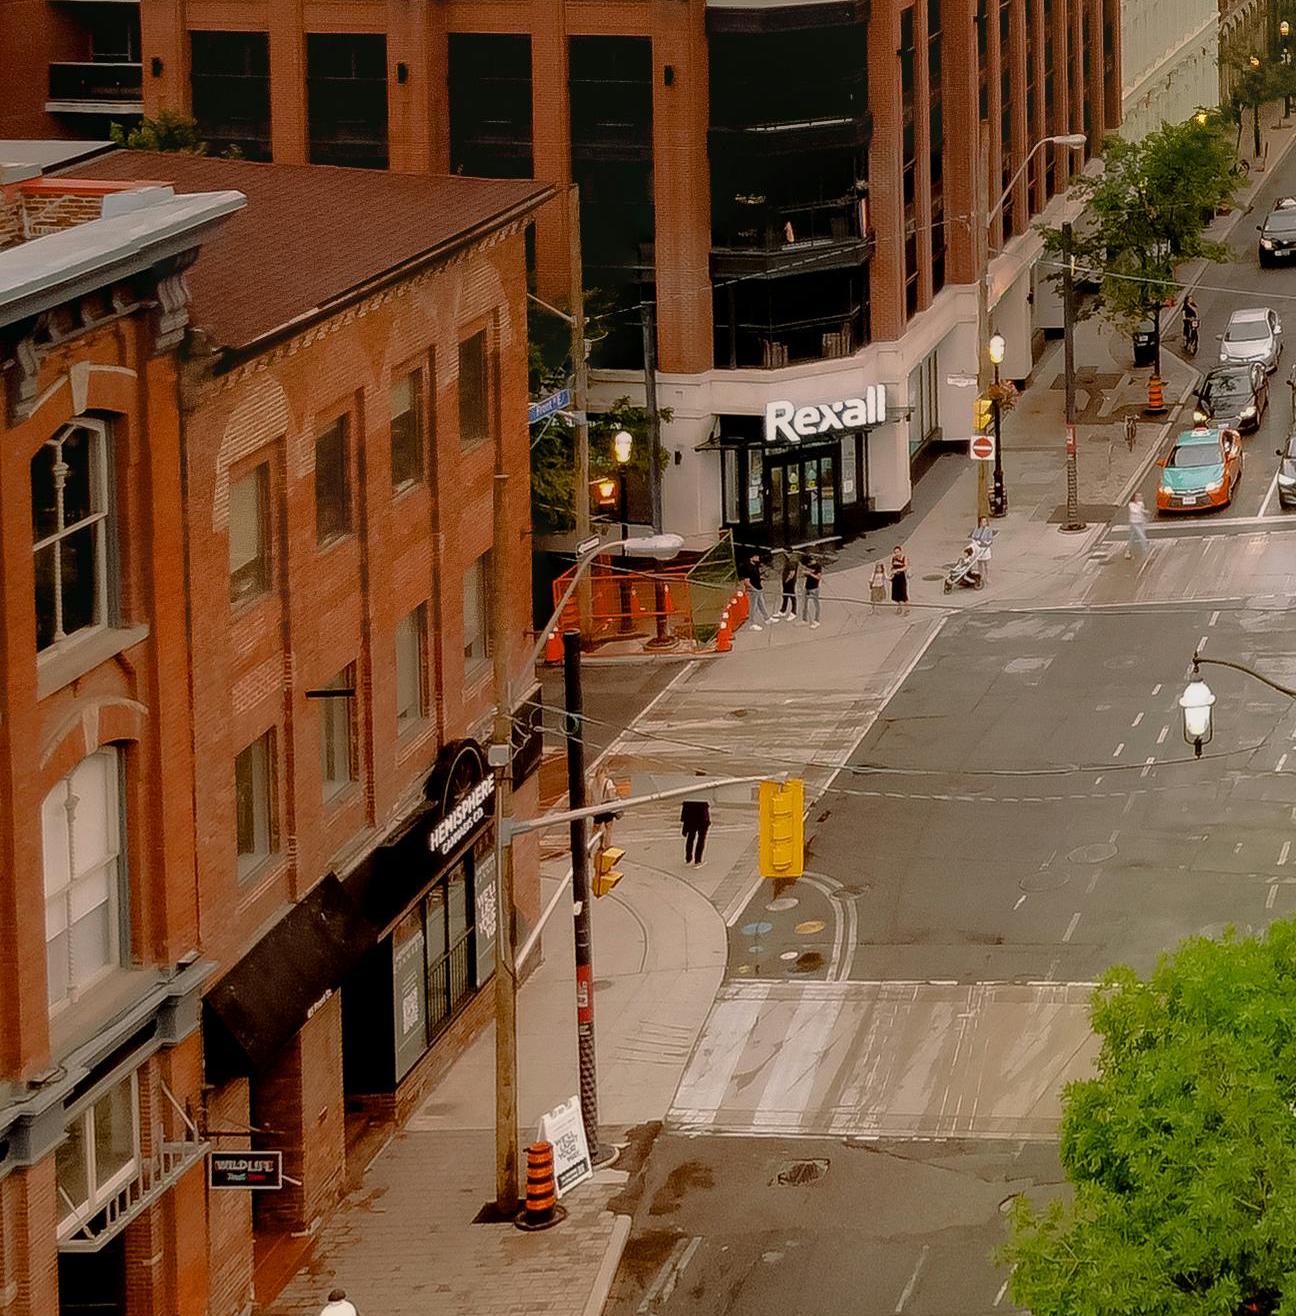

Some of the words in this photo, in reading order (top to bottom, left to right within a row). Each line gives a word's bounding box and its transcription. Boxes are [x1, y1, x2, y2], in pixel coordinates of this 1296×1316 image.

[766, 384, 886, 442] Rexall
[430, 772, 494, 852] HEMISPHERE
[214, 1160, 274, 1173] WILDLIFE
